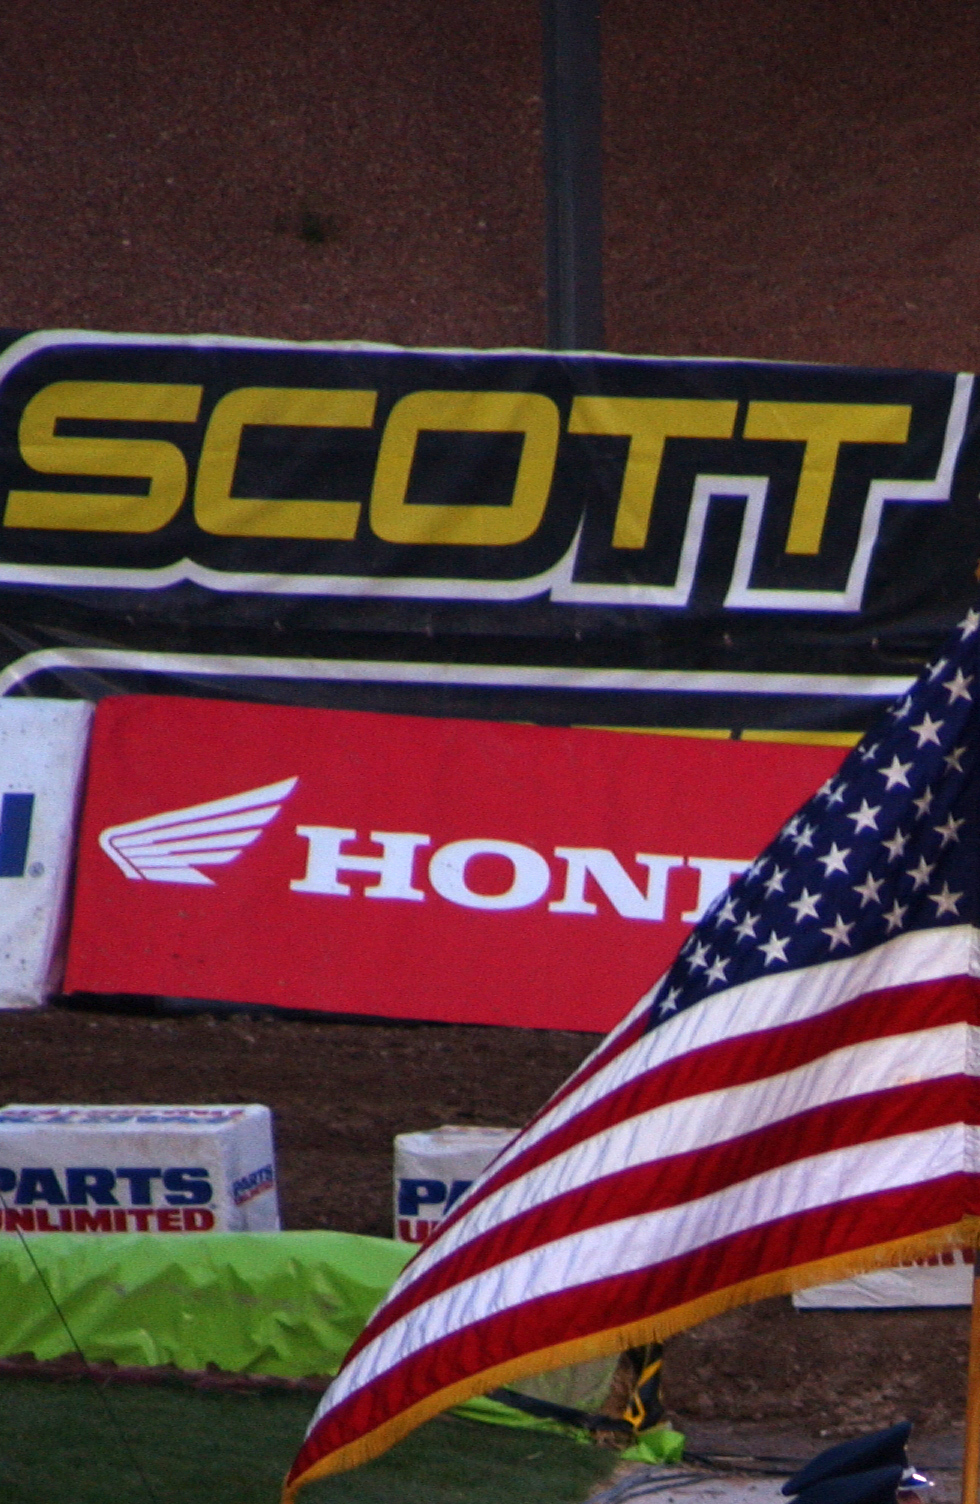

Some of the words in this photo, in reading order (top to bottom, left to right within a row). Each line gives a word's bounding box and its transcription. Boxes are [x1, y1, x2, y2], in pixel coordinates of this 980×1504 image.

[2, 379, 912, 555] SCOTT
[290, 825, 757, 924] HON
[0, 1209, 215, 1232] NLIMITED
